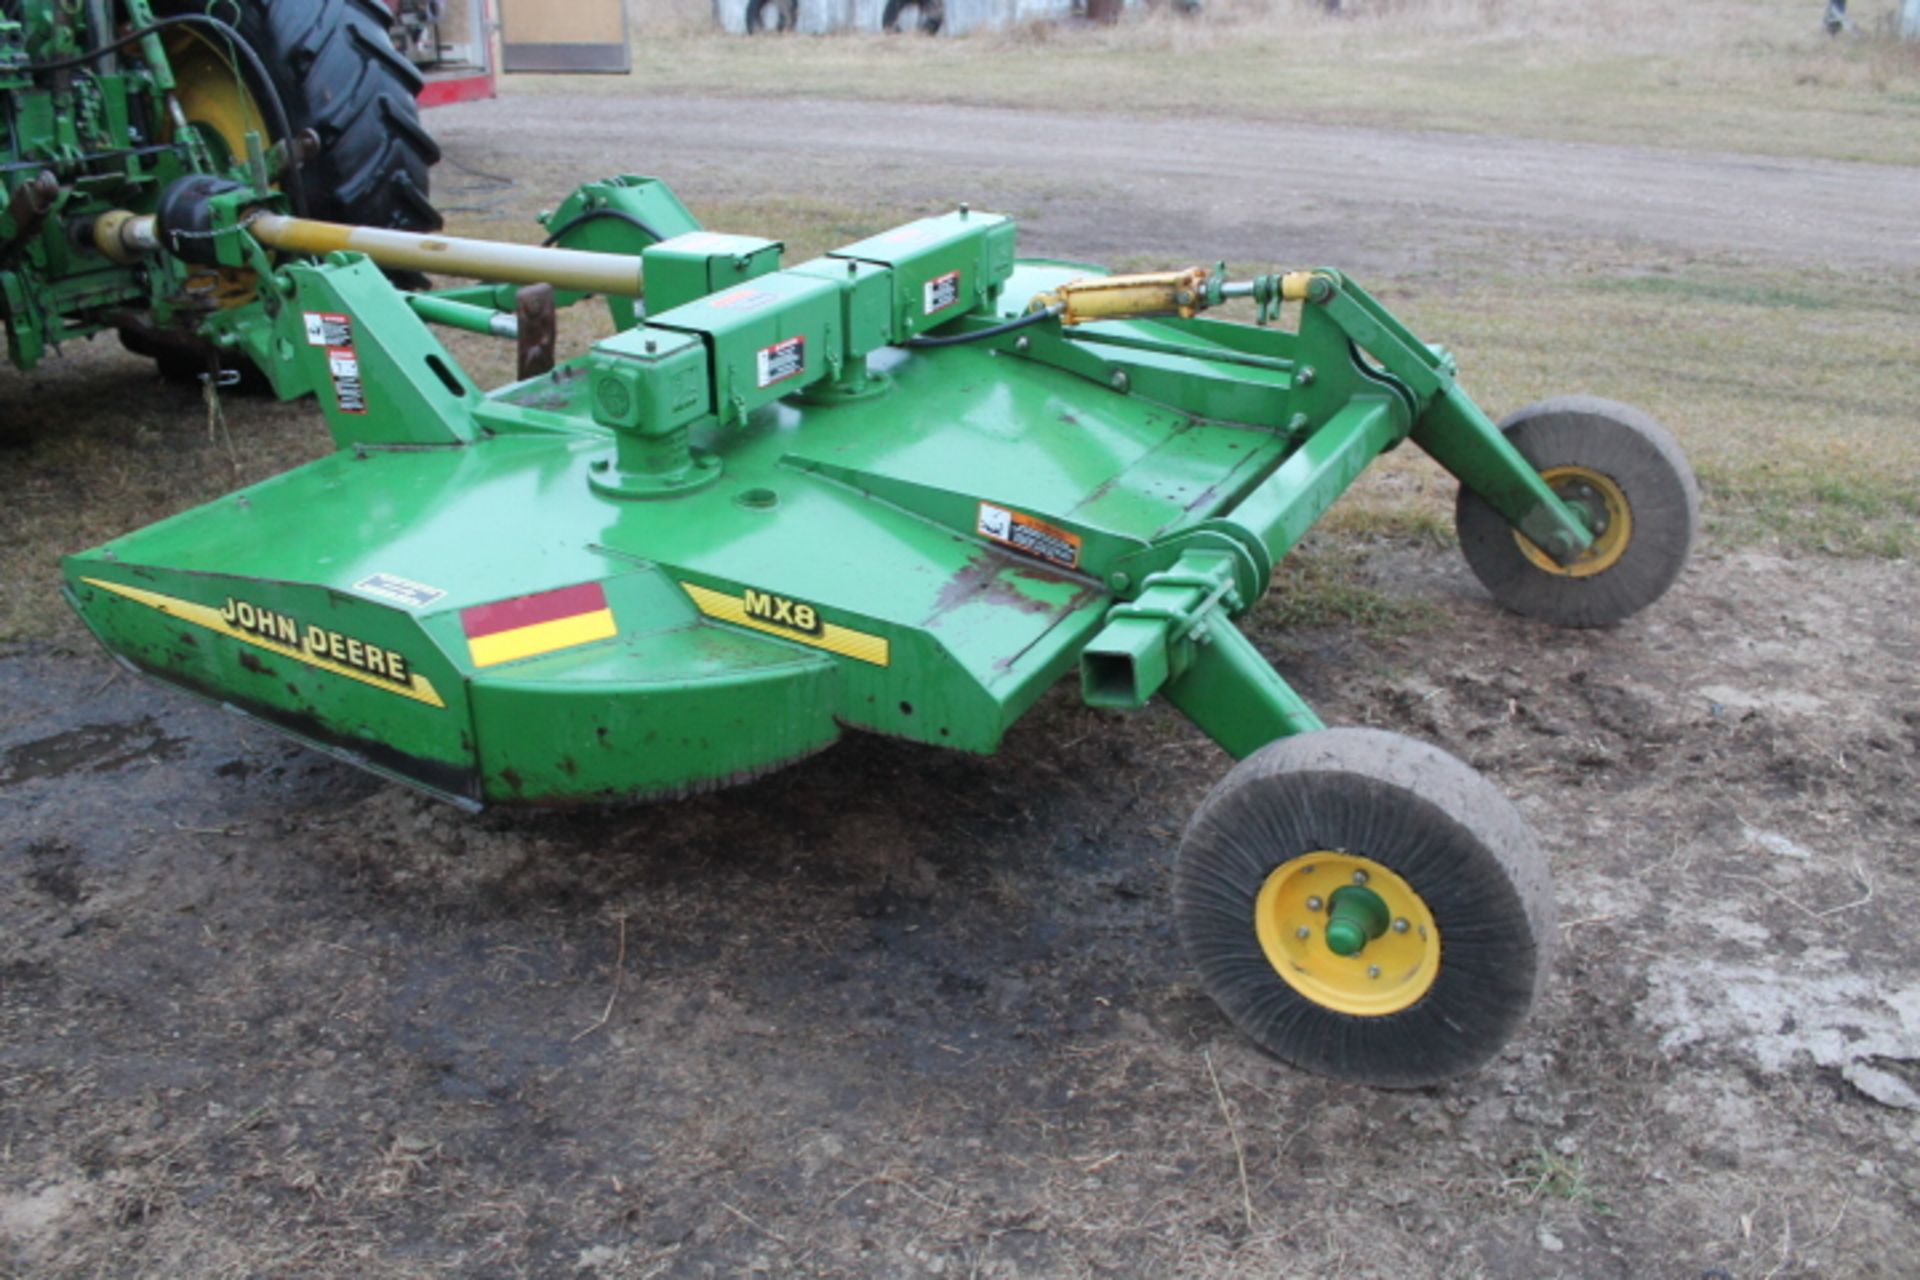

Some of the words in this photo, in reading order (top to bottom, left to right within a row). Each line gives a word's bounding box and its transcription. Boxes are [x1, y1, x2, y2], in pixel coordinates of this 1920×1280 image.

[221, 597, 298, 644] JOHN
[305, 625, 406, 681] DEERE
[745, 588, 816, 631] MX8
